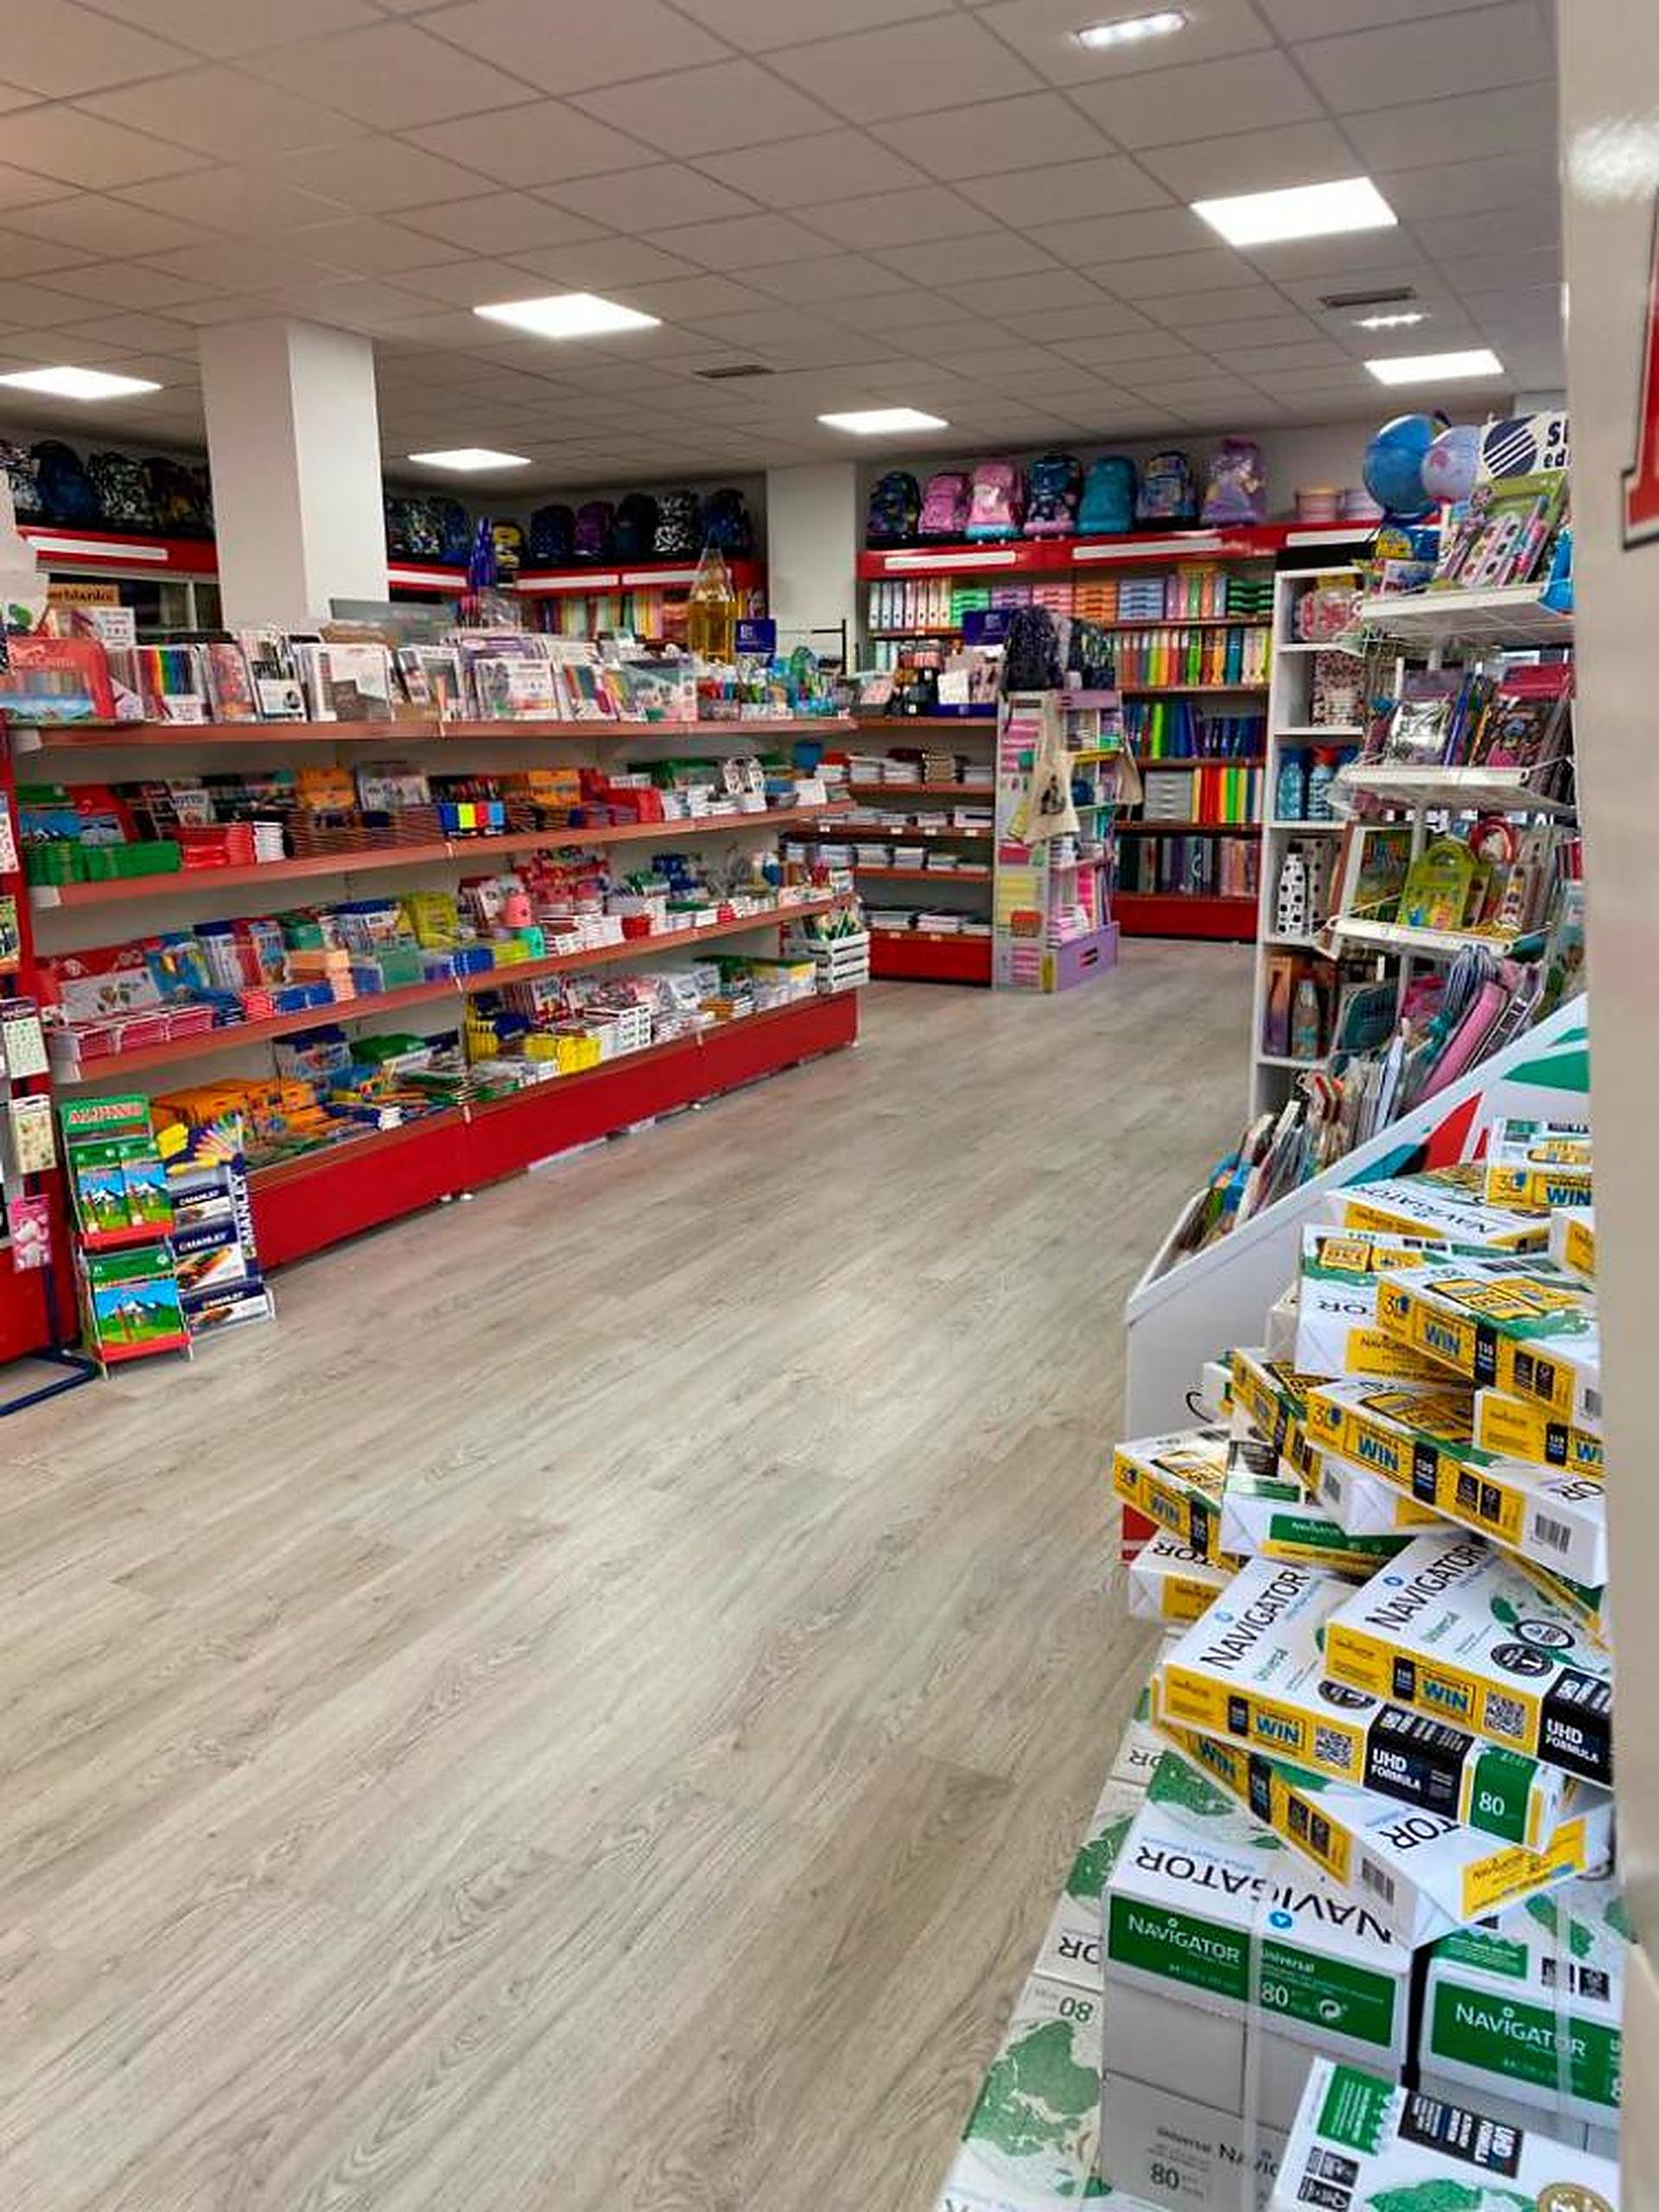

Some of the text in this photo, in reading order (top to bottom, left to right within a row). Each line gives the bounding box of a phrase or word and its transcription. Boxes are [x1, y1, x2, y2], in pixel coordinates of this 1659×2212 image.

[1547, 1186, 1592, 1206] WIN
[1424, 1323, 1460, 1355] WIN
[1359, 1434, 1399, 1471] WIN
[1365, 1535, 1491, 1631] NAVIGATOR
[1199, 1569, 1311, 1670] NAVIGATOR
[1421, 1680, 1468, 1712] WIN
[1255, 1714, 1300, 1746] WIN
[1547, 1718, 1584, 1745] UHD
[1372, 1748, 1408, 1772] UHD
[1544, 1736, 1599, 1764] FORMULA
[1370, 1764, 1421, 1792] FORMULA
[1478, 1791, 1505, 1816] 80
[1127, 1913, 1241, 1963] NAVIGATOR
[1260, 1981, 1289, 2007] 80
[1058, 1996, 1093, 2023] 80
[1455, 2002, 1587, 2058] NAVIGATOR
[1150, 2163, 1179, 2190] 80
